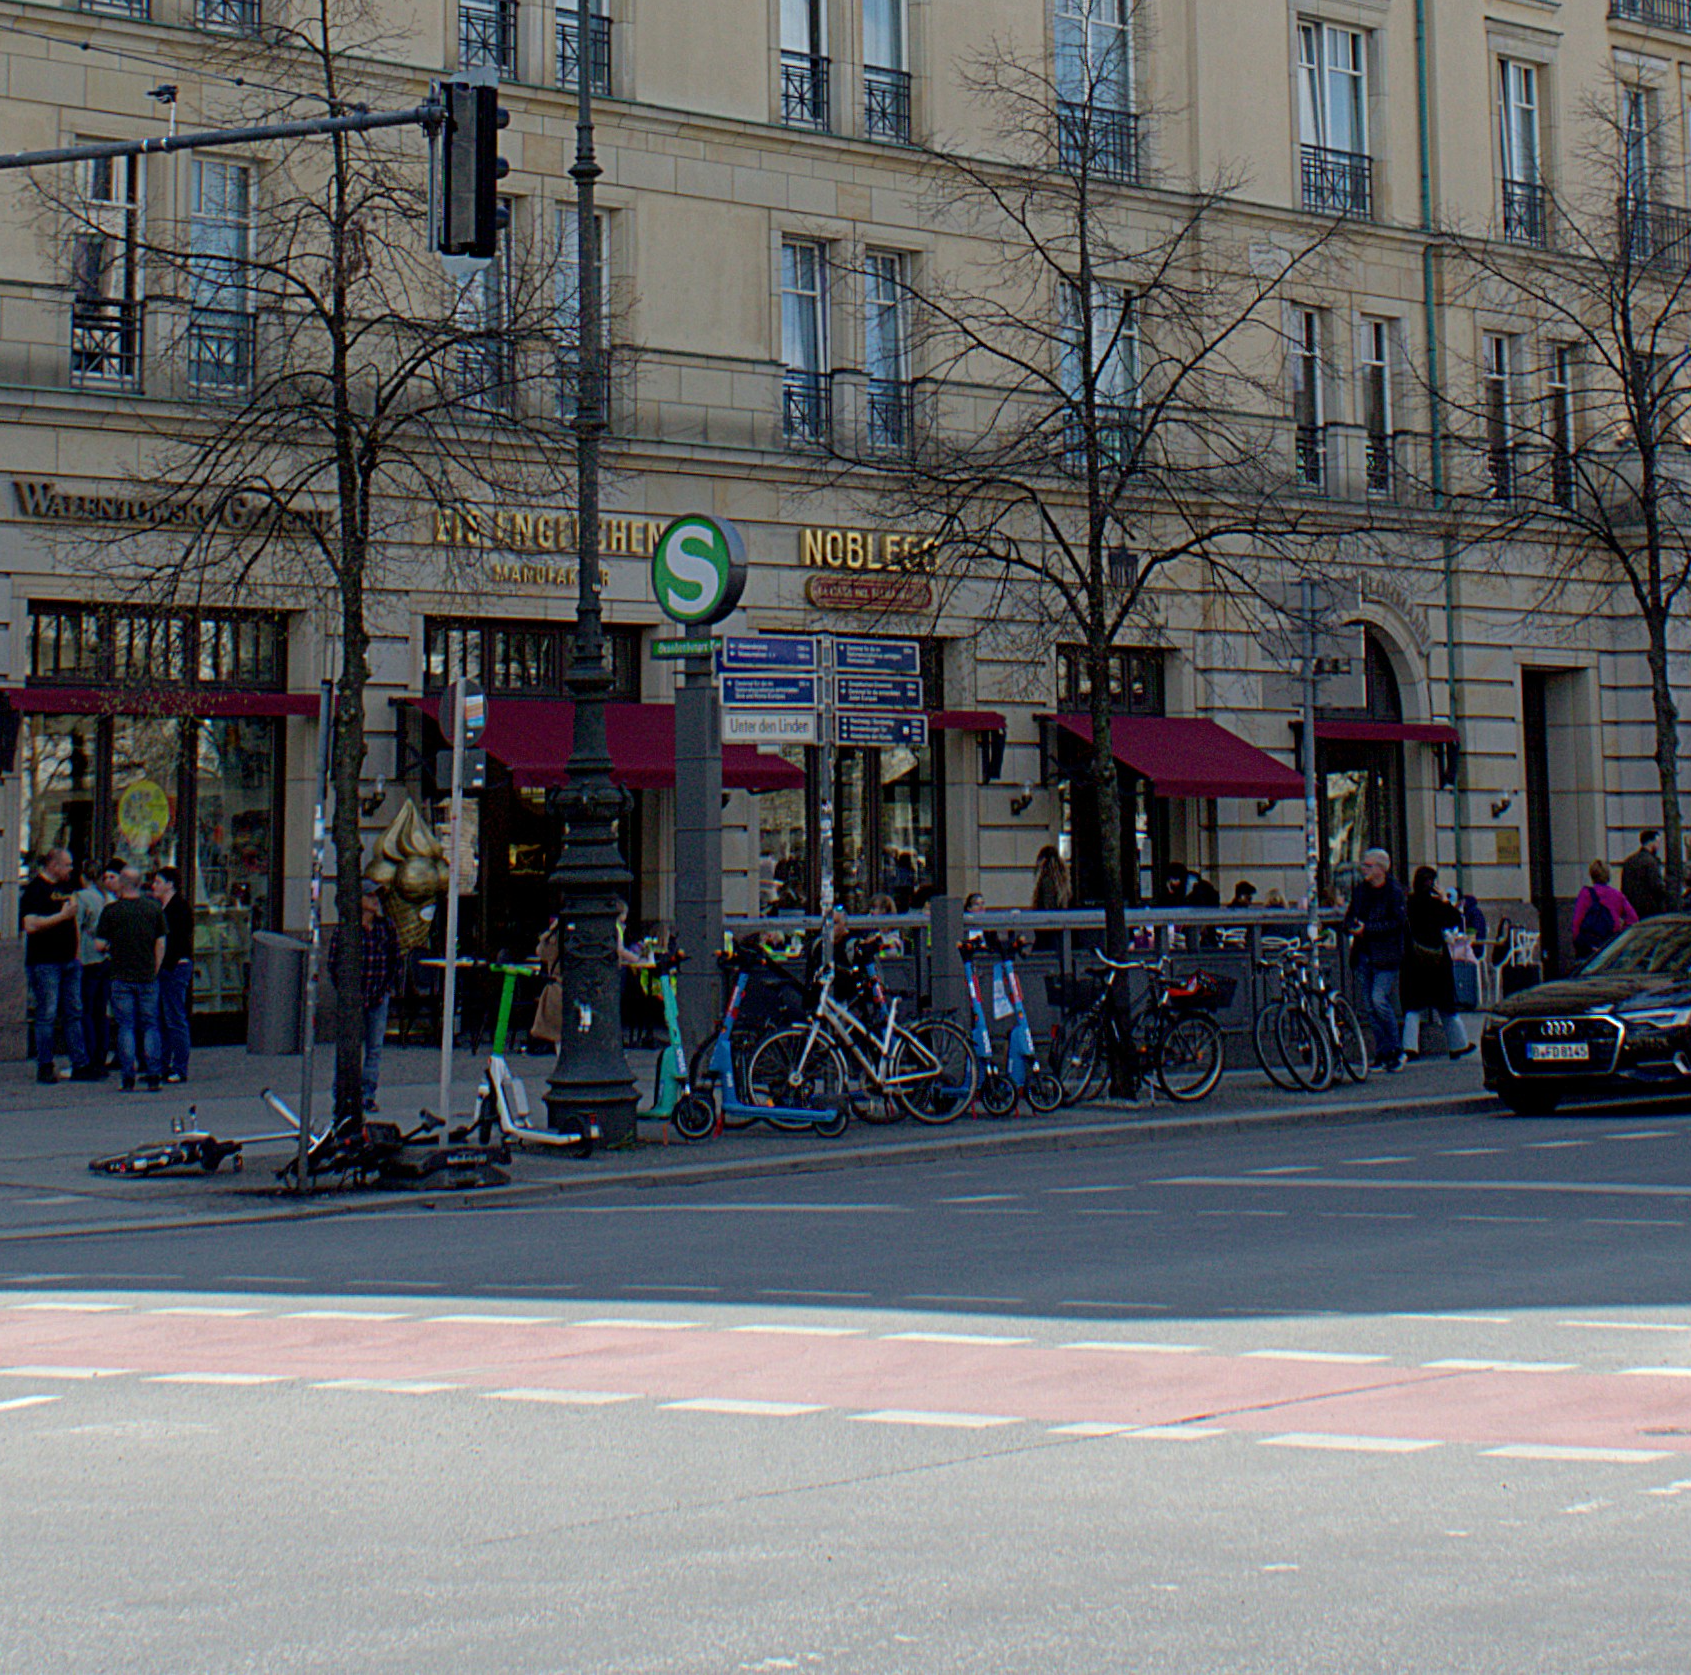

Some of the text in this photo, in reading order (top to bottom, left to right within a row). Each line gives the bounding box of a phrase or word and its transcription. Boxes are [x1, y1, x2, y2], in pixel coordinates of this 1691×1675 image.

[494, 509, 665, 554] ENGECHEN
[493, 563, 609, 588] MANUFAKR
[665, 526, 722, 615] S
[730, 717, 809, 734] Unter den Linden
